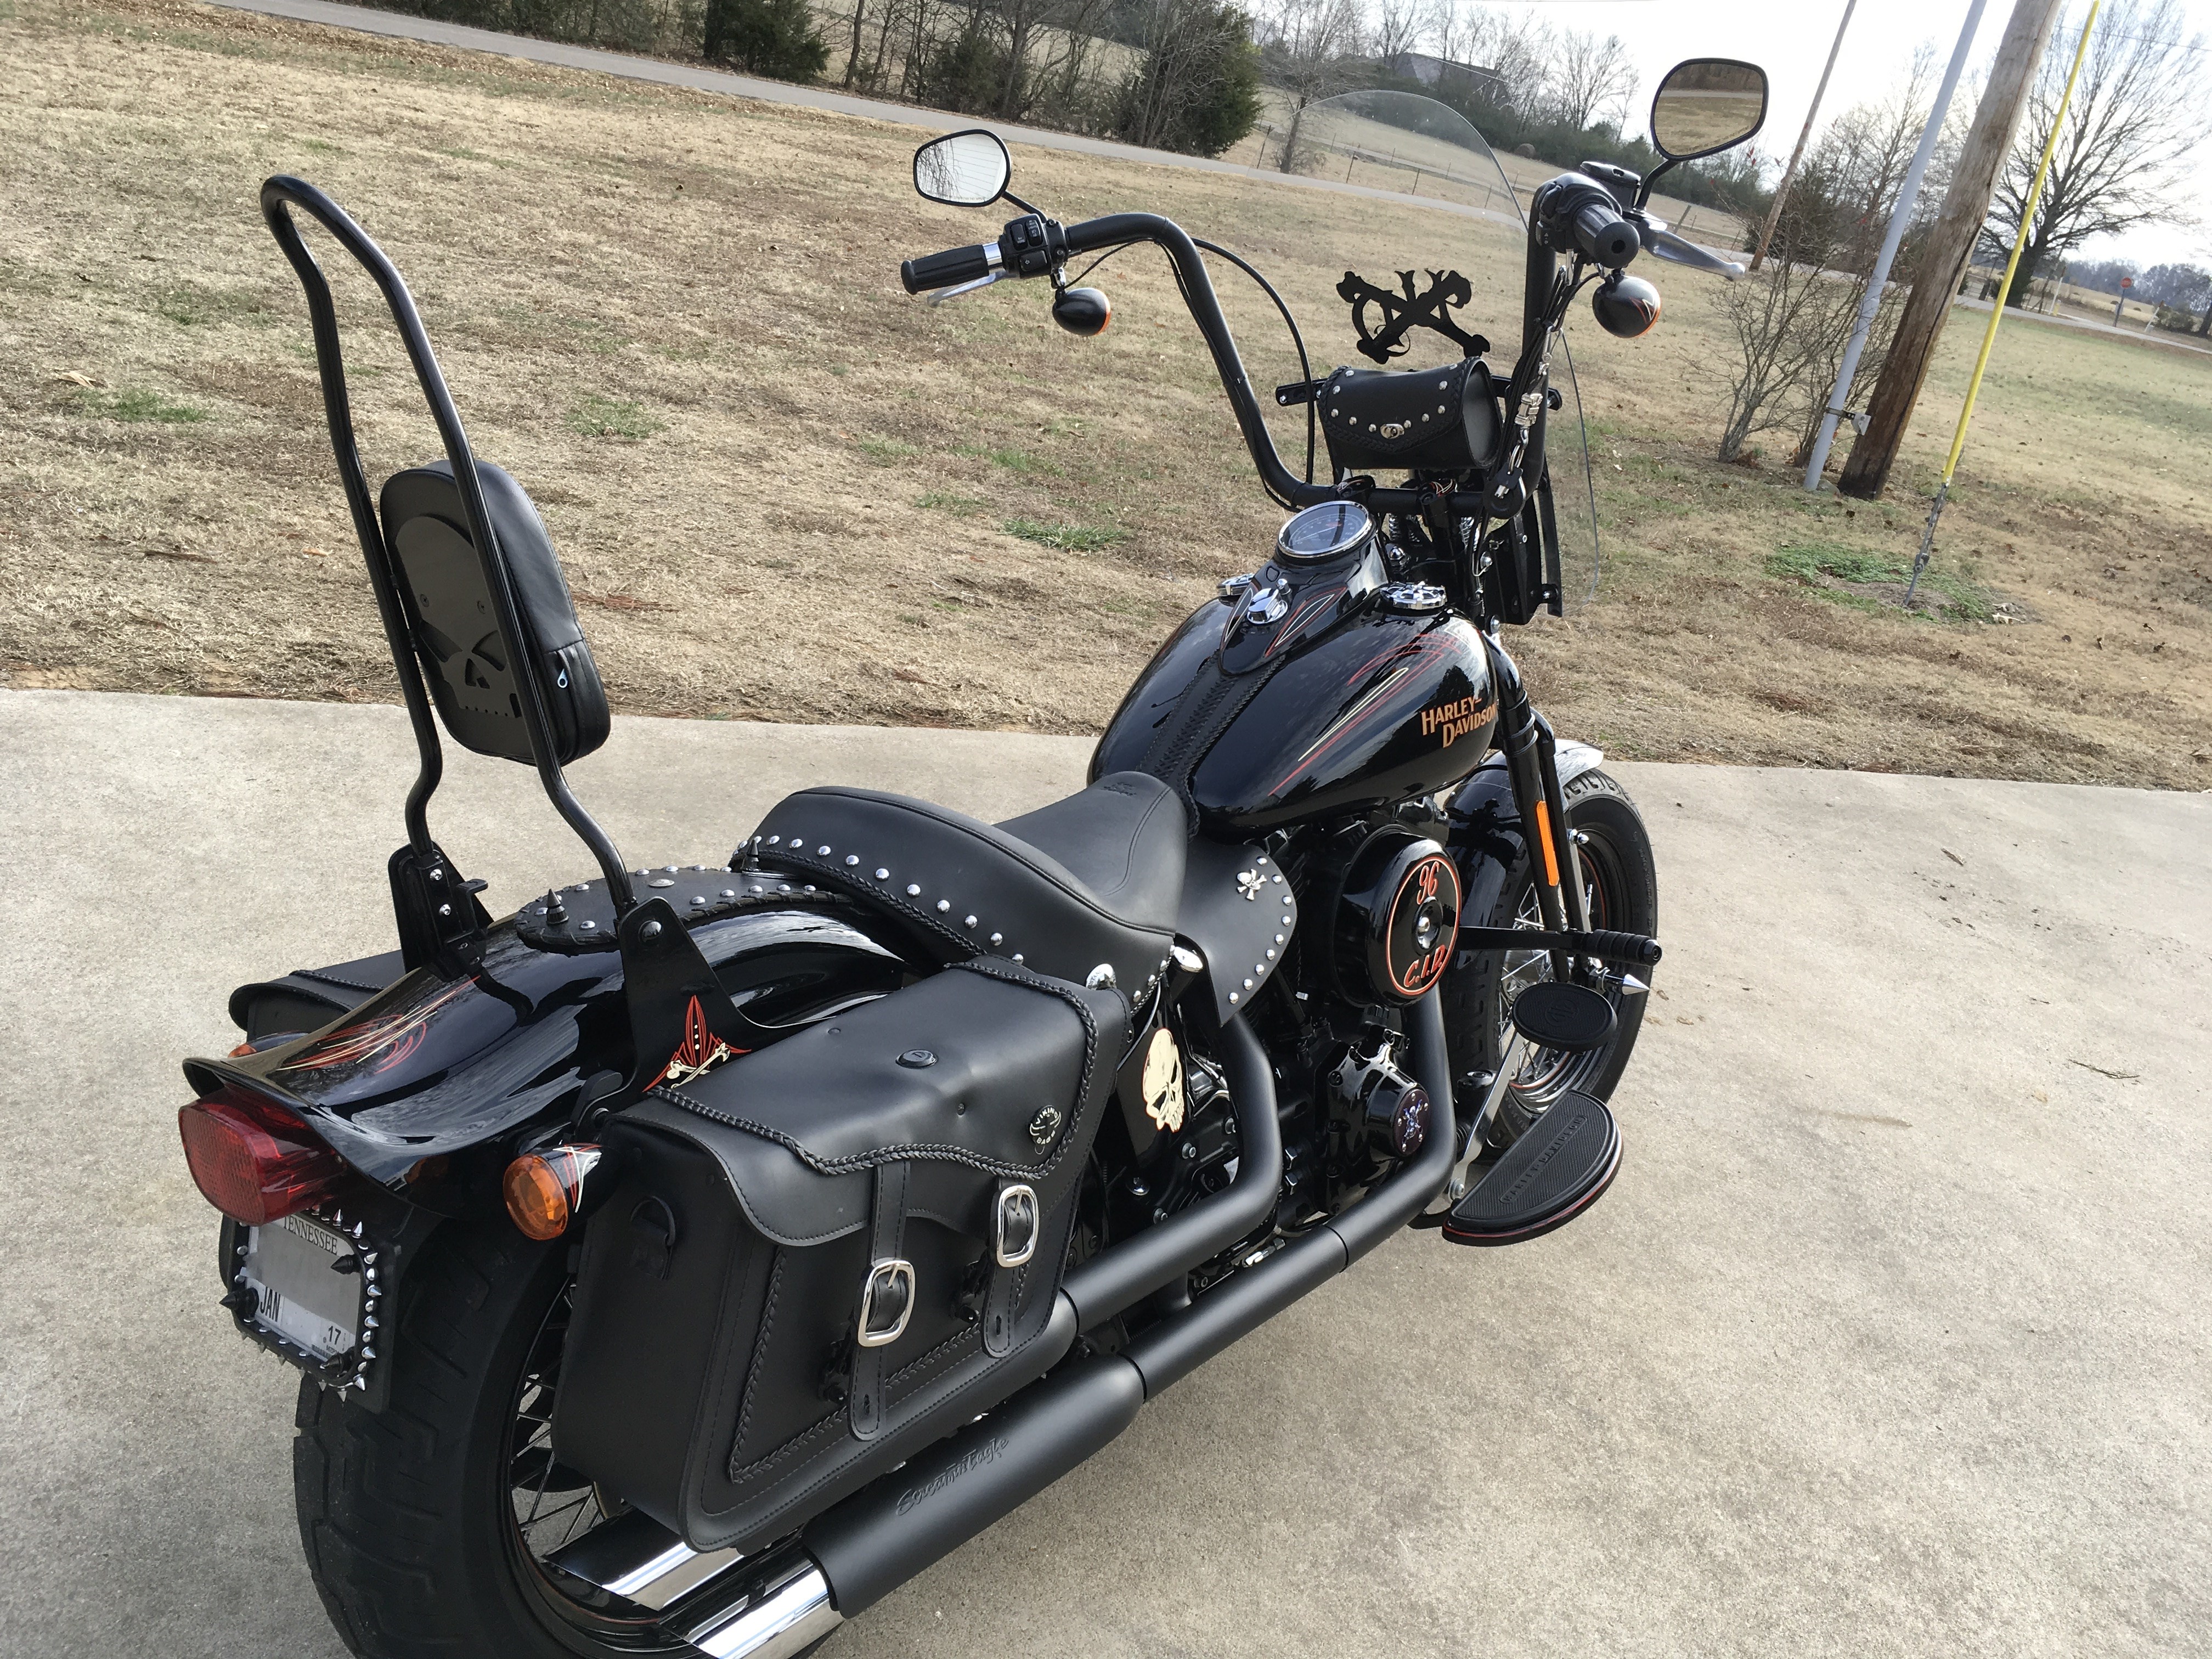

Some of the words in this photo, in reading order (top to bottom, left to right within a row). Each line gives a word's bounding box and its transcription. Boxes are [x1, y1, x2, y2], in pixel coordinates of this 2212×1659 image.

[1443, 703, 1497, 748] DAVIDSON
[1417, 861, 1439, 905] 96
[1036, 1107, 1058, 1124] VIKING
[284, 1215, 337, 1256] TENNESSEE
[260, 1286, 280, 1322] JAN
[329, 1325, 341, 1345] 17
